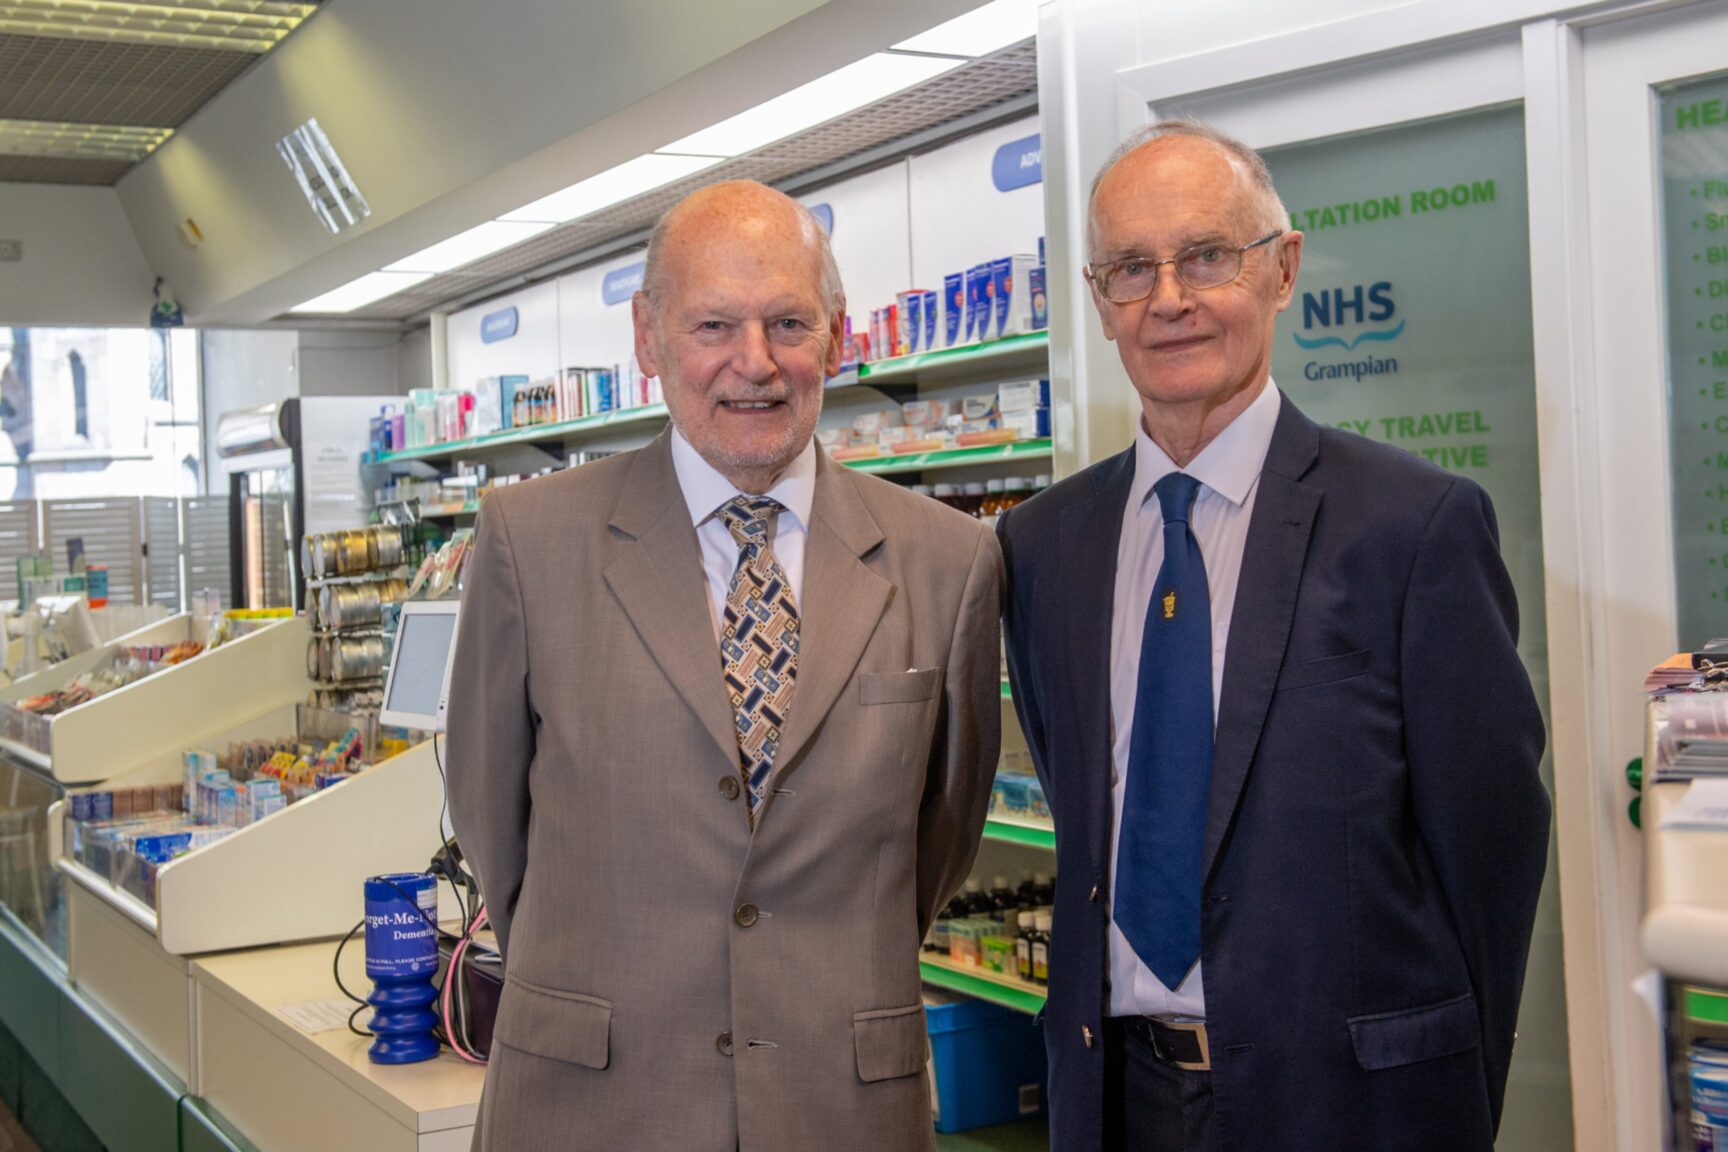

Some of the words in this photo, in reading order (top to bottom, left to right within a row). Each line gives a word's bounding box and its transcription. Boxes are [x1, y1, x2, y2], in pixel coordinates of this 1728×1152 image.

[1410, 178, 1496, 215] ROOM
[1302, 281, 1395, 330] NHS
[1304, 355, 1398, 382] Grampian
[1379, 410, 1490, 439] TRAVEL
